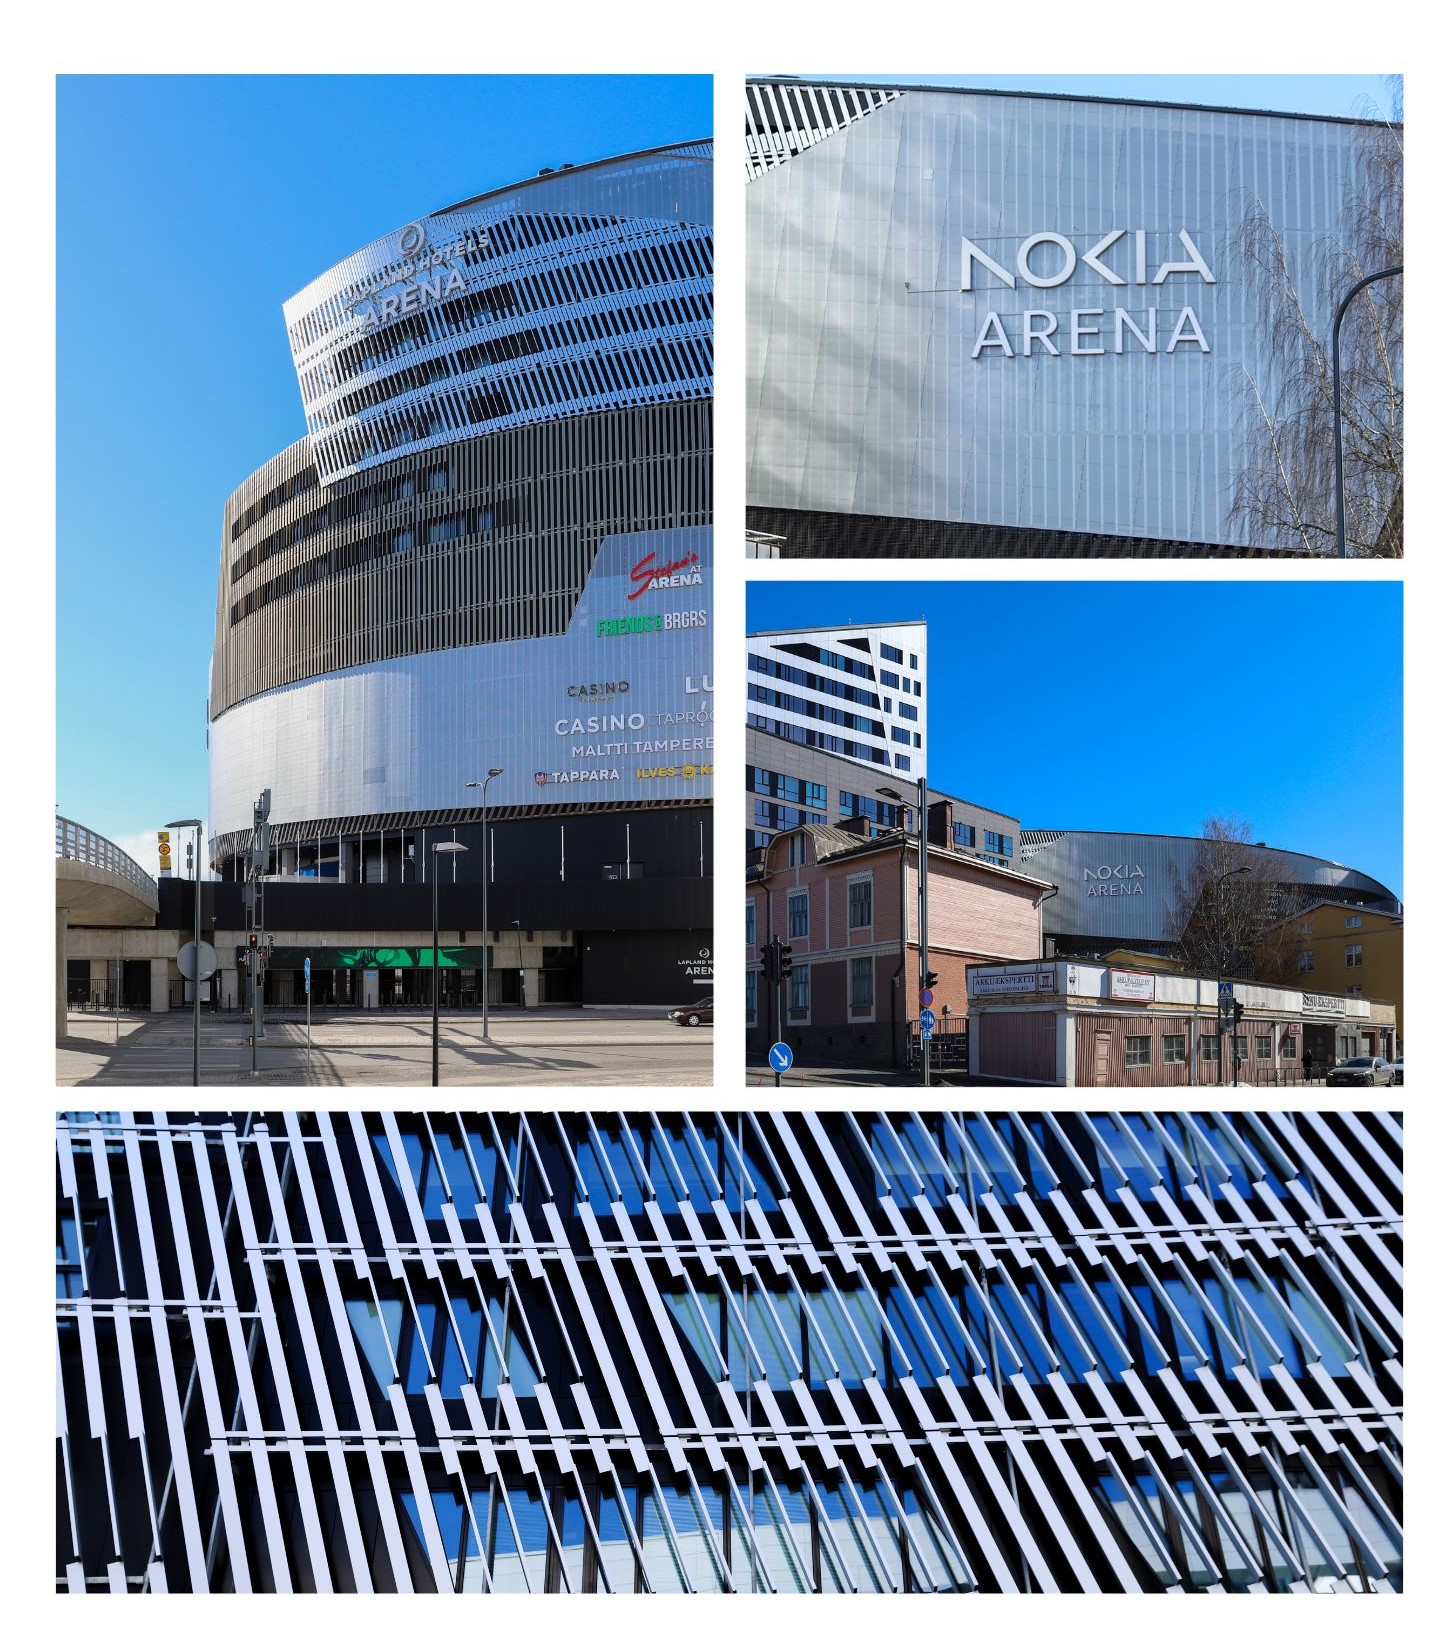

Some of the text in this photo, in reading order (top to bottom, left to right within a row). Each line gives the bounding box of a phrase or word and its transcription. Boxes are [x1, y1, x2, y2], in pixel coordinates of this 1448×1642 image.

[420, 234, 489, 269] HOTELS
[960, 228, 1217, 293] NOKIA
[361, 269, 468, 333] ARENA
[971, 306, 1211, 359] ARENA
[689, 565, 703, 574] AT
[648, 573, 704, 590] ARENA
[596, 615, 654, 637] FRIENDS
[664, 610, 708, 630] BRGRS
[567, 681, 630, 698] CASINO
[554, 713, 646, 736] CASINO
[572, 737, 714, 758] MALTTI TAMPERE
[552, 770, 620, 784] TAPPARA
[636, 767, 676, 779] ILVES
[1084, 864, 1145, 881] NOKIA
[1087, 883, 1144, 897] ARENA
